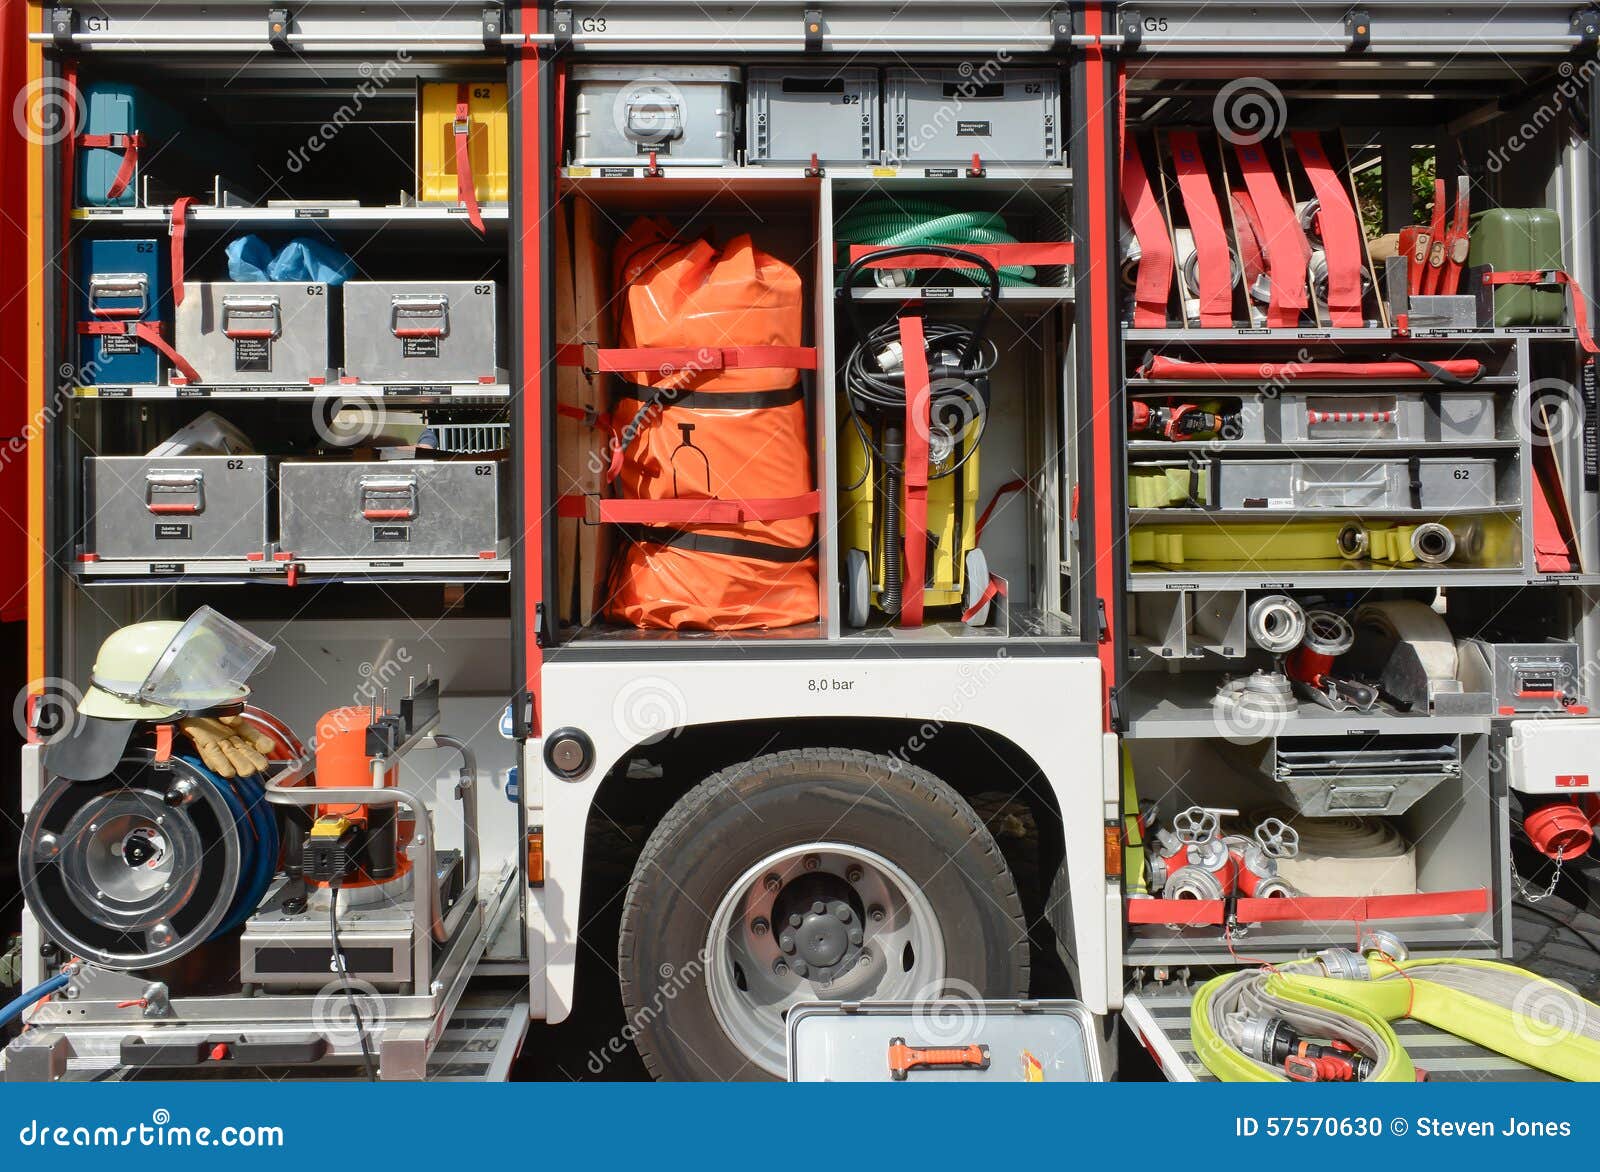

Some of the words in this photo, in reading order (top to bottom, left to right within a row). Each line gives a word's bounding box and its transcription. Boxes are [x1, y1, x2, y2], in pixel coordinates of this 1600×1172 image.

[87, 16, 110, 32] G1
[582, 17, 607, 33] G3
[1143, 17, 1168, 33] G5
[473, 88, 491, 99] 62
[1024, 83, 1041, 95] 62
[842, 94, 860, 105] 62
[136, 242, 154, 253] 62
[306, 285, 324, 296] 62
[474, 284, 491, 295] 62
[226, 459, 244, 470] 62
[474, 465, 492, 476] 62
[1453, 469, 1470, 480] 62
[808, 678, 828, 693] 8,0
[832, 678, 854, 690] bar
